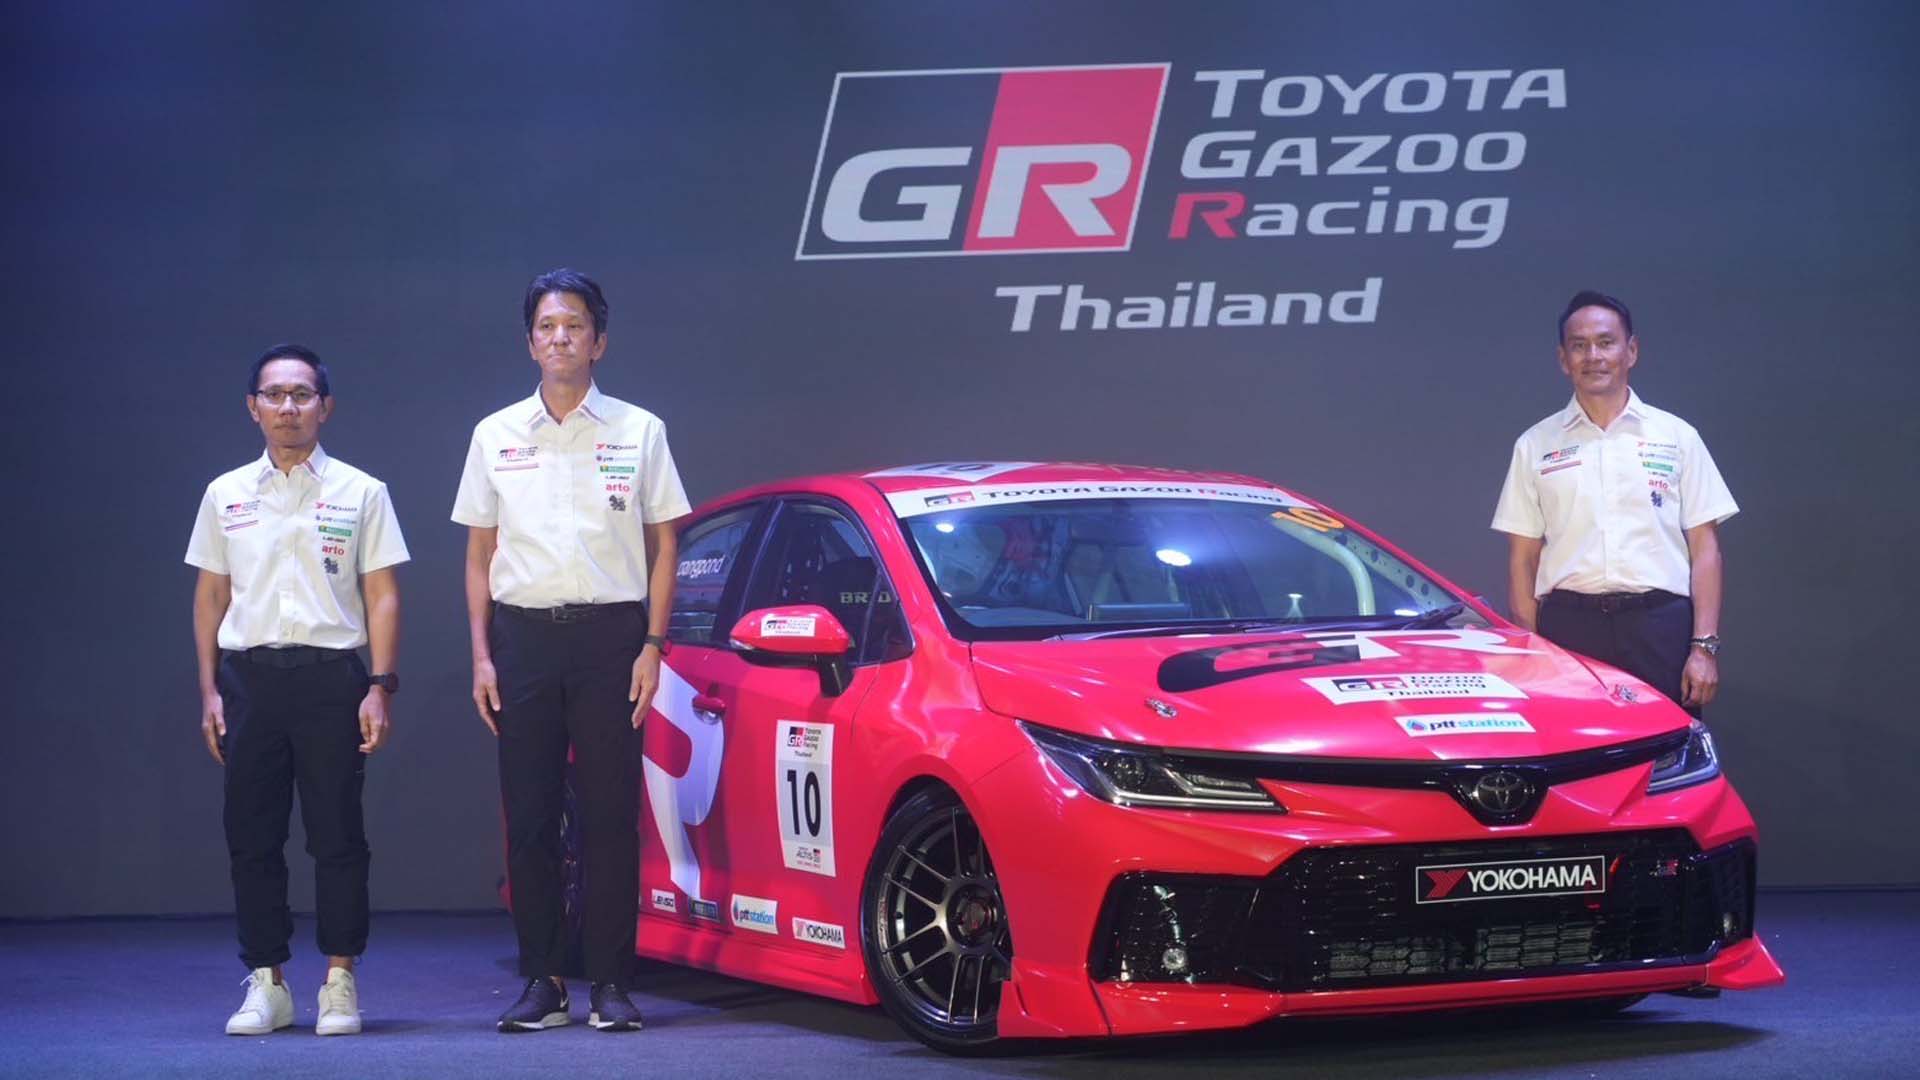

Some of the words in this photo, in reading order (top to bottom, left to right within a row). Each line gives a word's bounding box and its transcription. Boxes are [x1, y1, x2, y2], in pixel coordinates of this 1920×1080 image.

[1194, 68, 1568, 119] TOYOTA
[1180, 131, 1528, 179] GAZOO
[821, 143, 1133, 243] GR
[1168, 186, 1510, 250] Racing
[995, 277, 1384, 333] Thailand
[606, 483, 630, 493] arto
[982, 486, 1092, 498] TOYOTA
[1099, 486, 1193, 494] GAZOO
[1198, 488, 1283, 503] Racing
[1271, 507, 1345, 533] 10
[321, 544, 345, 556] arto
[787, 769, 822, 838] 10
[1467, 864, 1598, 893] YOKOHAMA
[806, 923, 843, 943] YOKOHAMA
